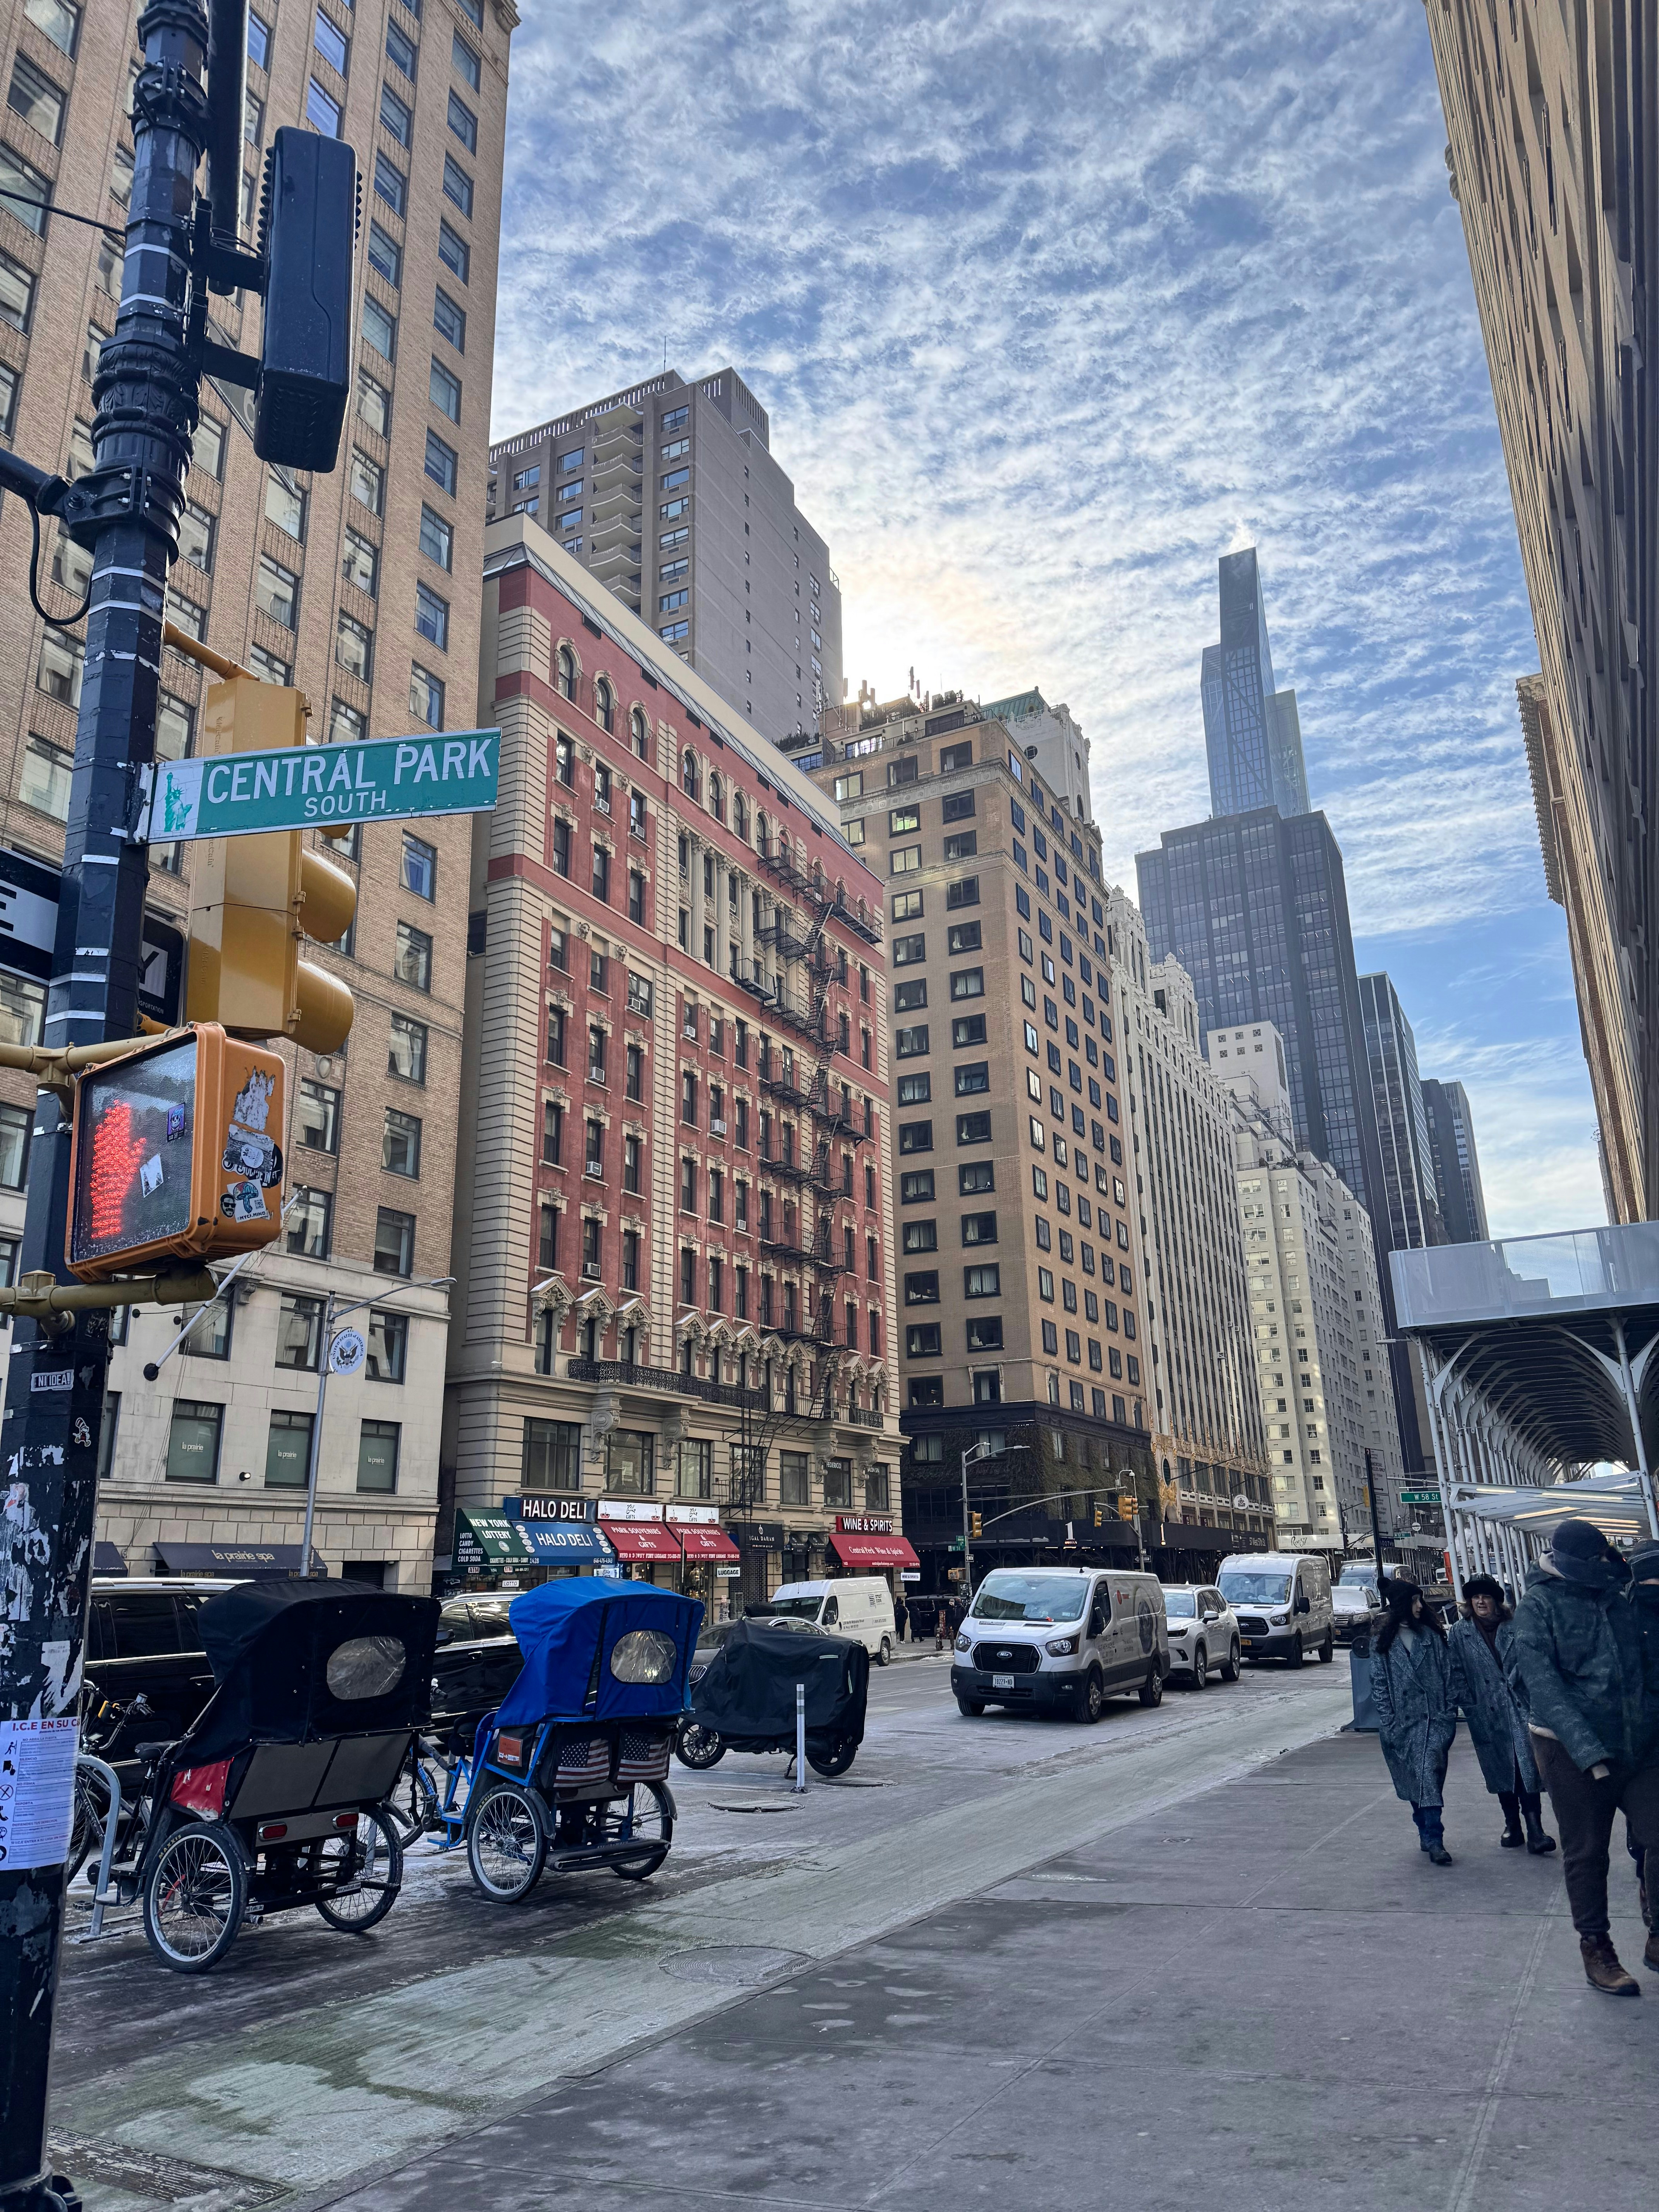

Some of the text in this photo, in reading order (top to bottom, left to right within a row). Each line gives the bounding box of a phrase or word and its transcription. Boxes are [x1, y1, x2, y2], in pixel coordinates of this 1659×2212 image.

[207, 738, 492, 804] CENTRAL PARK
[304, 790, 386, 817] SOUTH
[340, 1333, 352, 1342] STATES
[49, 1372, 70, 1386] IDEA!
[187, 1443, 203, 1452] prairie
[523, 1499, 587, 1519] HALO DELI
[469, 1518, 511, 1528] NEW YORK
[843, 1517, 893, 1532] WINE & SPIRITS
[481, 1530, 511, 1539] LOTTERY
[1065, 1521, 1075, 1540] 1
[535, 1533, 593, 1546] HALO DELI
[211, 1549, 275, 1563] la prairie spa
[186, 1570, 203, 1578] prairie
[41, 1721, 54, 1729] EN
[57, 1719, 69, 1728] SU
[158, 1834, 182, 1859] MAXXIS
